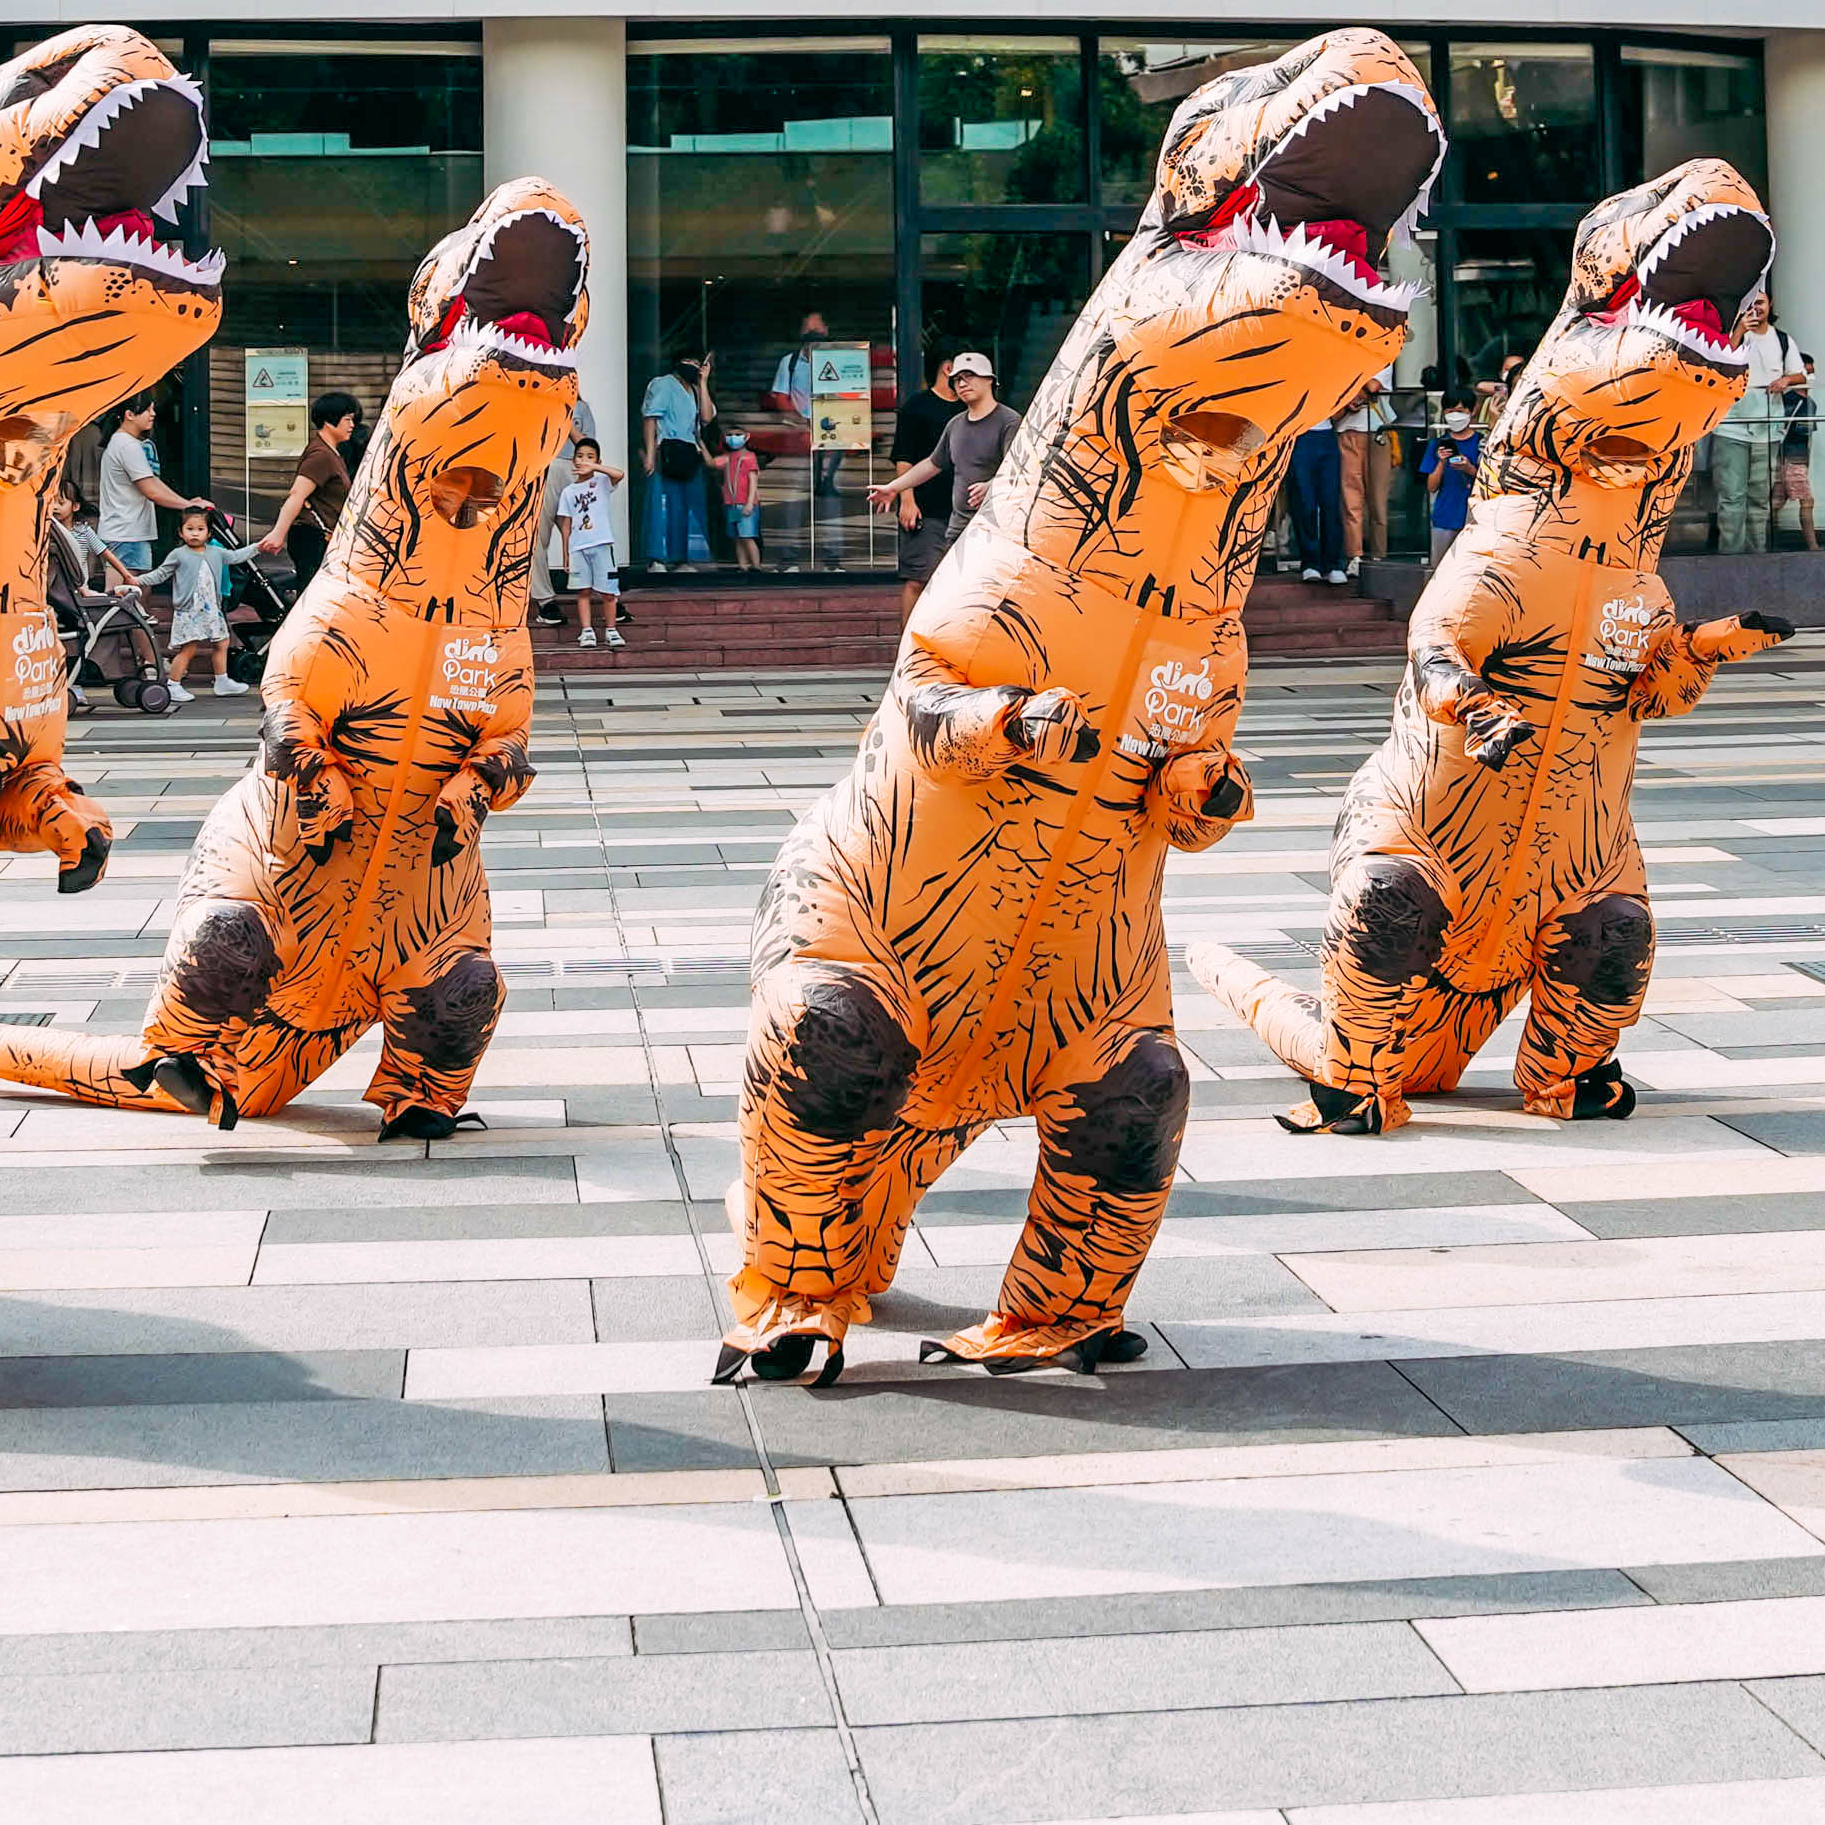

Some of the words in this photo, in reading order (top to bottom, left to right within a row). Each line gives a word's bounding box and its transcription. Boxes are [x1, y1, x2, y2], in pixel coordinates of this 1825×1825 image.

[1602, 596, 1651, 626] dino
[13, 614, 55, 655] dino
[444, 634, 498, 664] dino
[1600, 619, 1649, 649] Park
[15, 655, 59, 685] Park
[442, 658, 497, 687] Park
[1150, 658, 1213, 700] dino
[1144, 686, 1205, 731] Park
